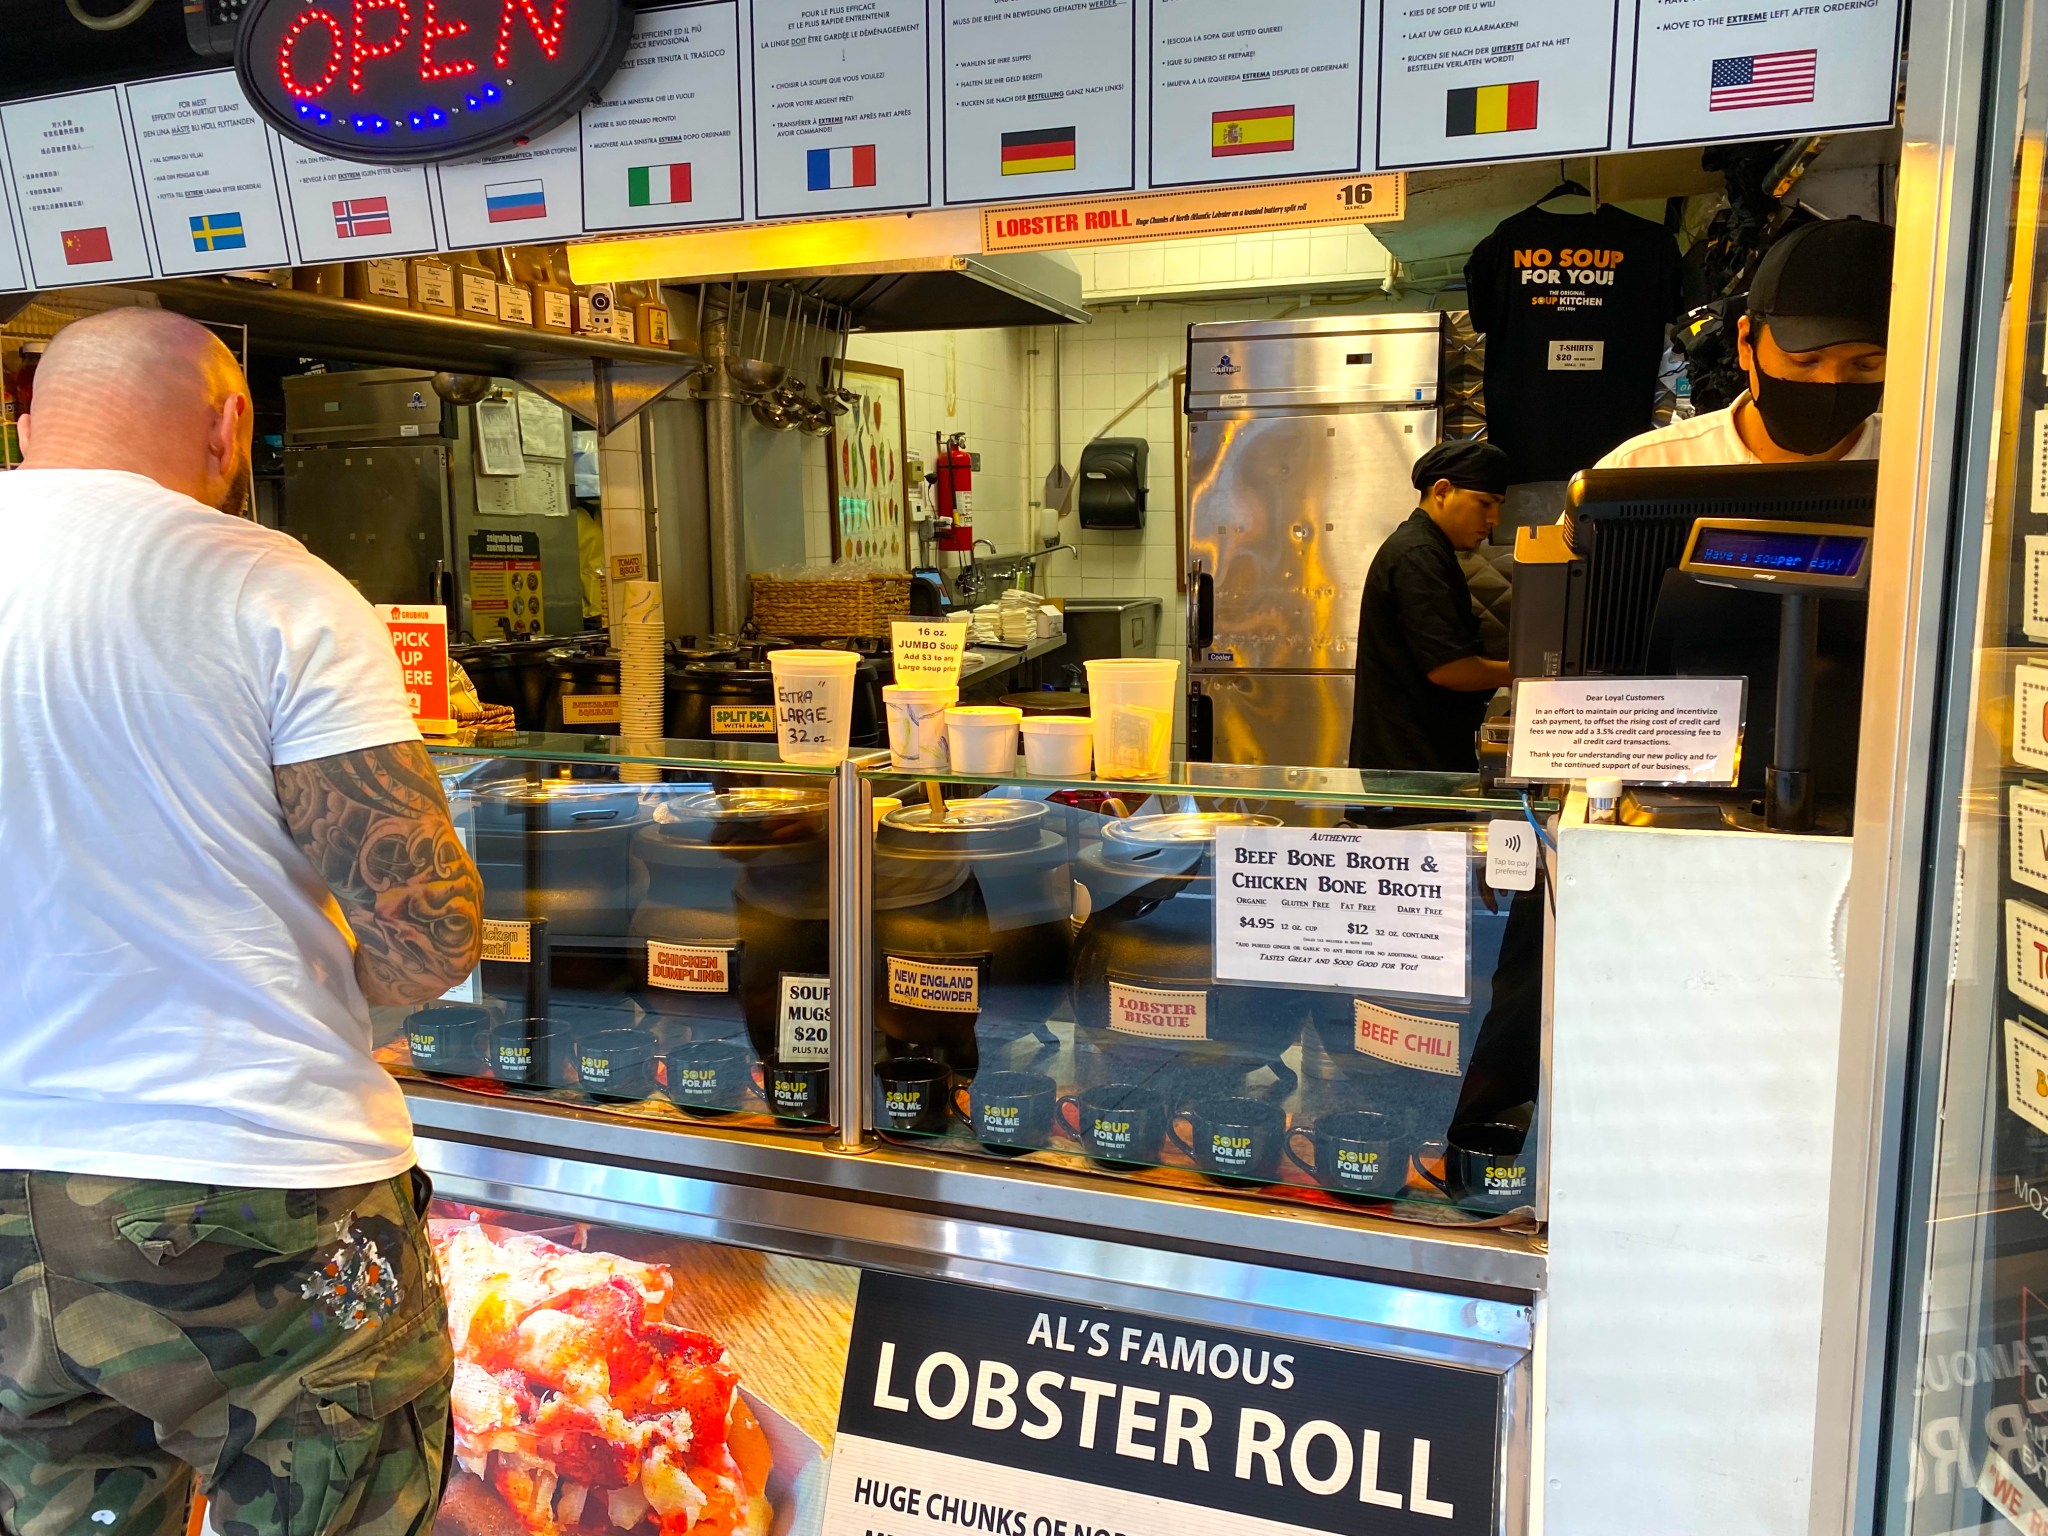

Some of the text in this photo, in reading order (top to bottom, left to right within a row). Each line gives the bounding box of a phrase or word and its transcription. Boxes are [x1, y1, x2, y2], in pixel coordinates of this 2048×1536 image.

[801, 2, 876, 18] POUR LE PLUS EFFICACE
[1409, 1, 1496, 17] KIES DE SOEP DIE U WIL!
[1662, 0, 1879, 31] MOVE TO THE EXTREME LEFT AFTER ORDERING!
[278, 0, 567, 97] OPEN
[1336, 183, 1372, 205] $16
[1212, 210, 1231, 218] Lobster
[996, 208, 1132, 238] LOBSTER ROLL
[1513, 248, 1624, 269] NO SOUP
[1521, 269, 1615, 286] FOR YOU!
[1531, 296, 1603, 306] SOUP KITCHEN
[1559, 344, 1594, 352] T-SHIRTS
[1556, 353, 1572, 361] $20
[1704, 548, 1842, 571] Have a souper day!
[401, 611, 429, 620] GRUBHUB
[393, 631, 430, 647] PICK
[918, 627, 930, 636] 16
[898, 640, 959, 652] JUMBO Soup
[401, 650, 423, 666] UP
[921, 653, 932, 661] $3
[943, 655, 954, 663] any
[1210, 653, 1231, 661] Cooler
[897, 663, 920, 672] Large
[922, 665, 942, 673] soup
[405, 669, 433, 686] ERE
[1604, 694, 1624, 702] Loyal
[716, 710, 772, 723] SPLIT PEA
[779, 706, 828, 725] LARGE
[1554, 707, 1574, 715] effort
[1585, 707, 1618, 715] maintain
[1633, 707, 1659, 716] pricing
[1660, 707, 1675, 715] and
[1676, 707, 1718, 715] incentivize
[788, 727, 810, 745] 32
[1309, 832, 1362, 843] AUTHENTIC
[1234, 847, 1439, 873] BEEF BONE BROTH &
[1494, 857, 1507, 866] Tap
[1516, 860, 1530, 868] pay
[1495, 868, 1527, 876] preferred
[1232, 872, 1442, 899] CHICKEN BONE BROTH
[1236, 897, 1443, 915] ORGANIC GLUTEN FREE FAT FREE DAIRY FREE
[481, 926, 518, 942] icken
[1239, 915, 1274, 929] $4.95
[1347, 922, 1368, 935] $12
[1401, 931, 1439, 940] CONTAINER
[481, 942, 511, 956] entil
[657, 951, 718, 969] CHICKEN
[1259, 953, 1285, 962] TASTES
[1287, 954, 1313, 964] GREAT
[1314, 957, 1330, 965] AND
[1357, 959, 1379, 968] GOOD
[1381, 962, 1396, 970] FOR
[652, 964, 725, 983] DUMPLING
[894, 968, 973, 989] NEW ENGLAND
[894, 983, 973, 1003] CLAM CHOWDER
[1118, 996, 1197, 1015] LOBSTER
[1124, 1010, 1191, 1028] BISQUE
[794, 1026, 828, 1043] $20
[1361, 1019, 1452, 1058] BEEF CHILI
[792, 1046, 829, 1055] PLUS TAX
[682, 1069, 716, 1080] SOUP
[682, 1078, 717, 1088] FOR ME
[984, 1104, 1019, 1117] SOUP
[983, 1115, 1020, 1126] FOR ME
[1026, 1312, 1295, 1389] AL'S FAMOUS
[873, 1341, 1453, 1519] LOBSTER ROLL
[854, 1477, 921, 1516] HUGE
[926, 1493, 1027, 1536] CHUNKS
